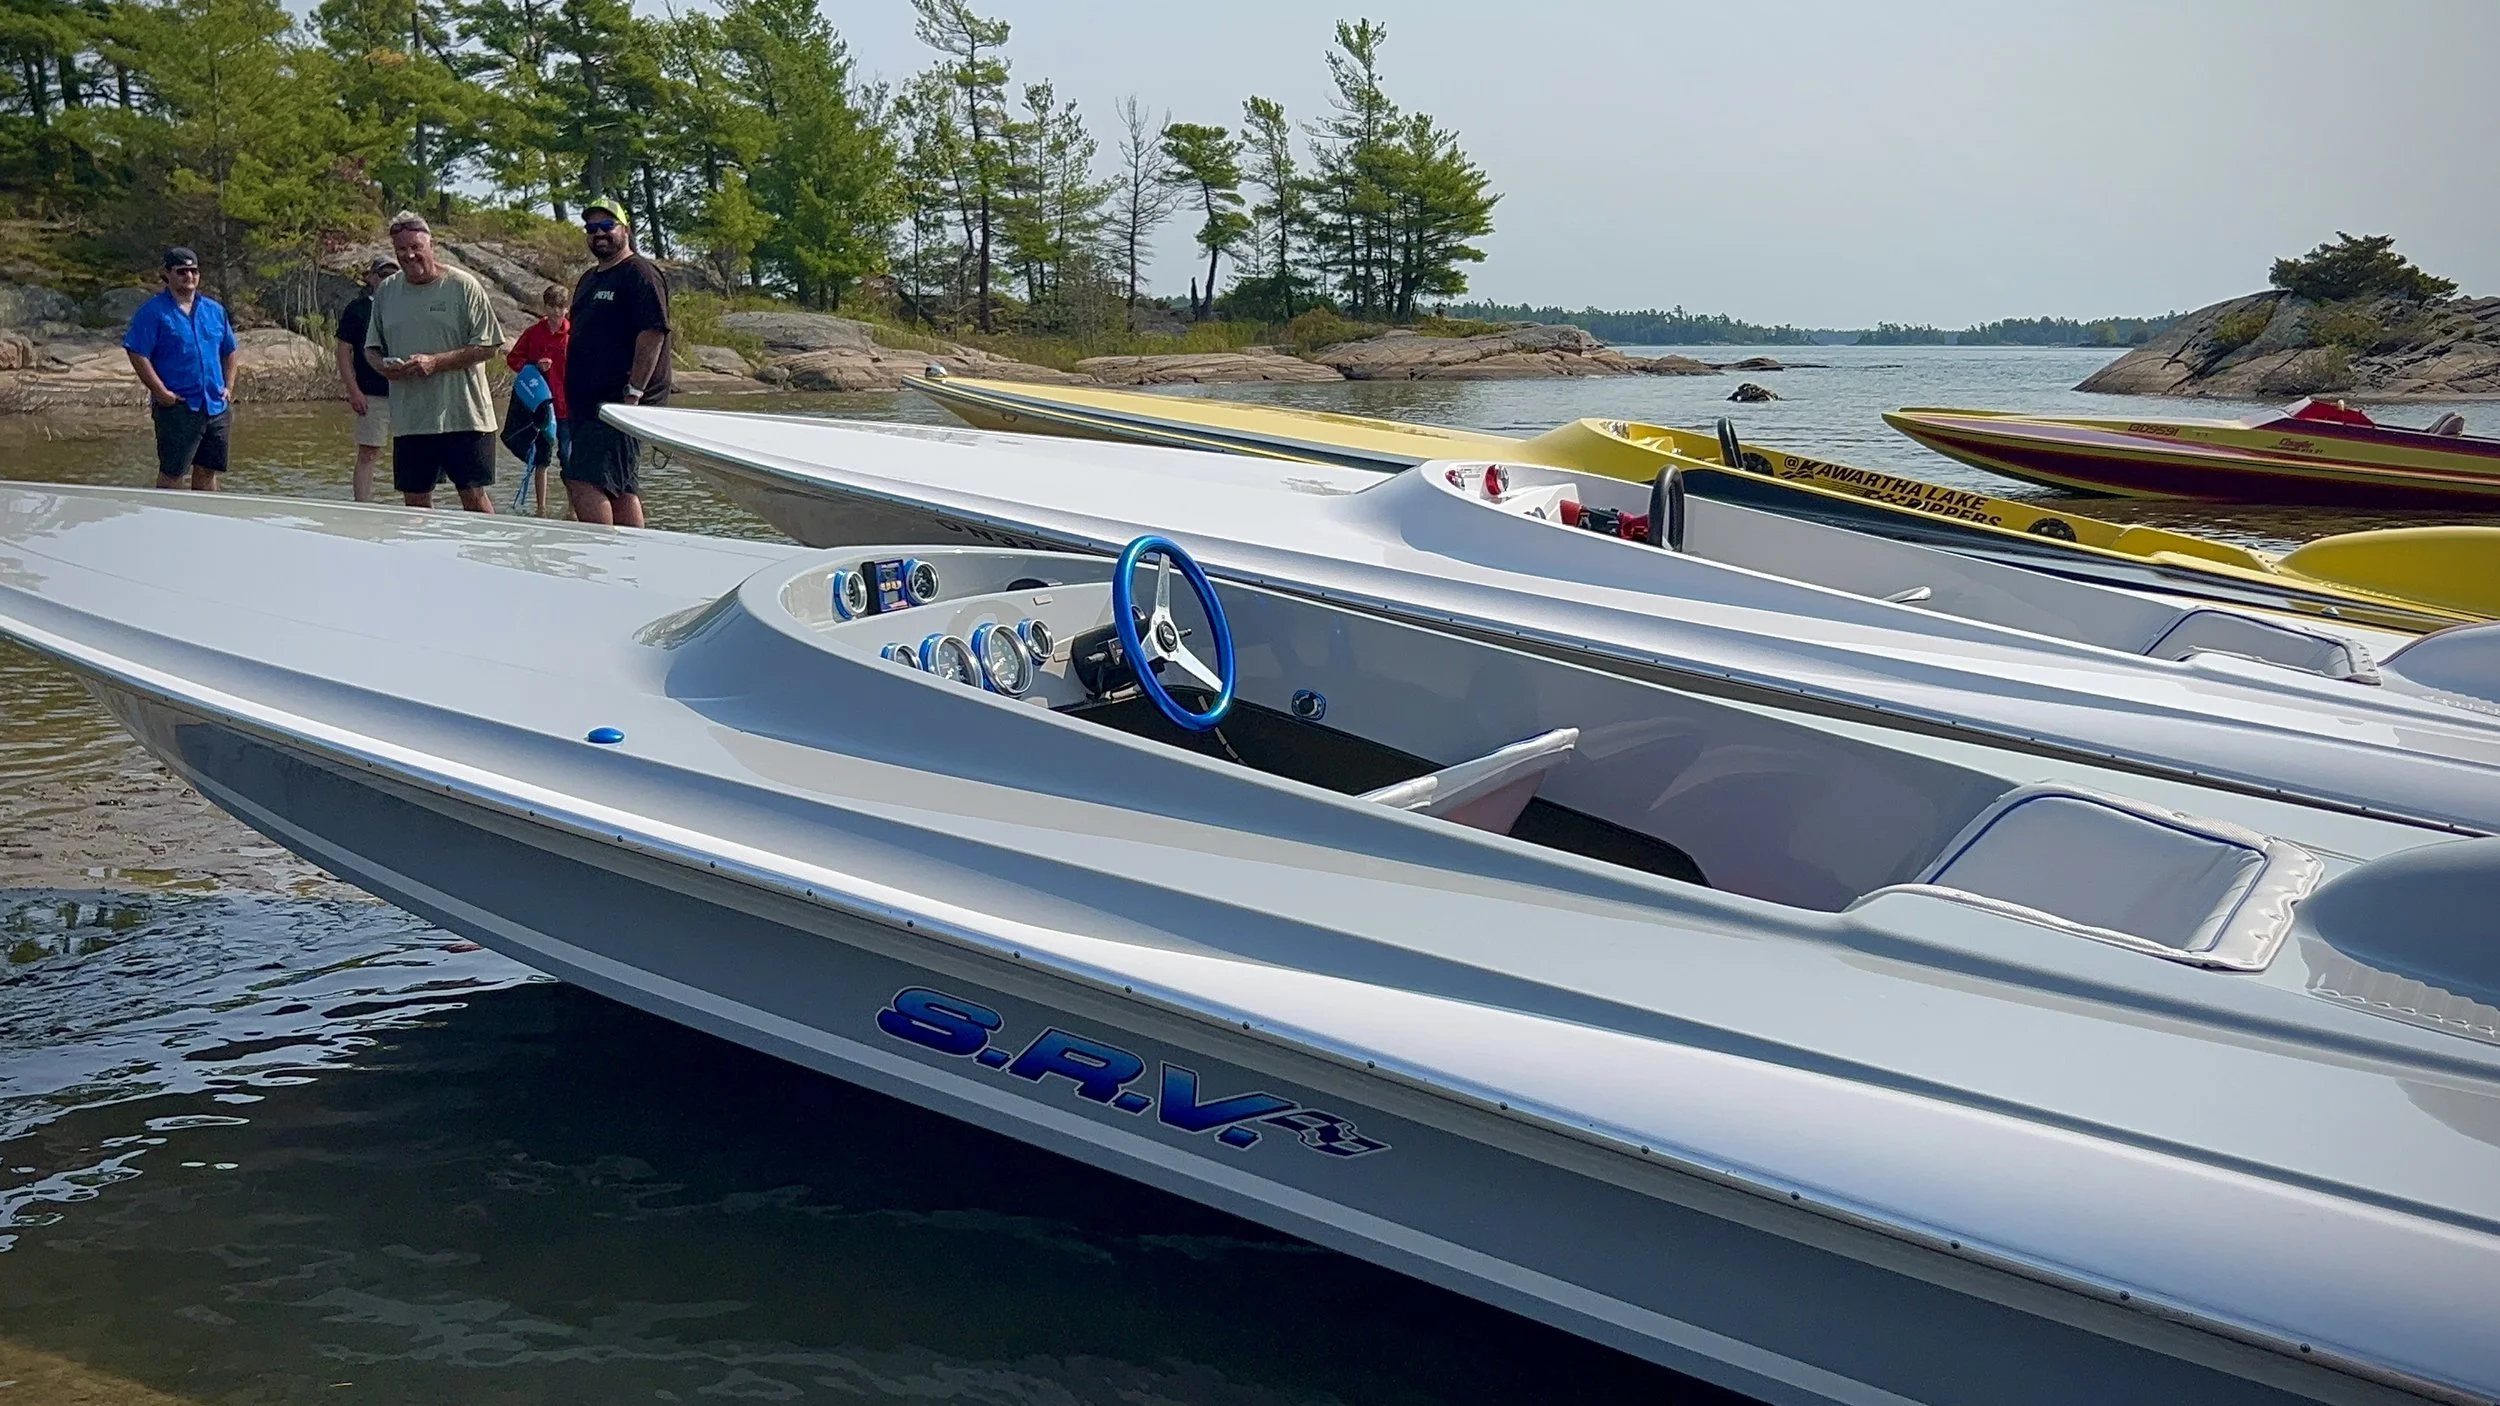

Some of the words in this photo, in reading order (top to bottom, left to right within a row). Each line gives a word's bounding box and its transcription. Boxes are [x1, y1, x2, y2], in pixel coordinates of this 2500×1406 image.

[1784, 455, 1923, 497] @KAWARTHA
[1925, 487, 1989, 511] LAKE
[875, 985, 1300, 1151] S.R.V.
